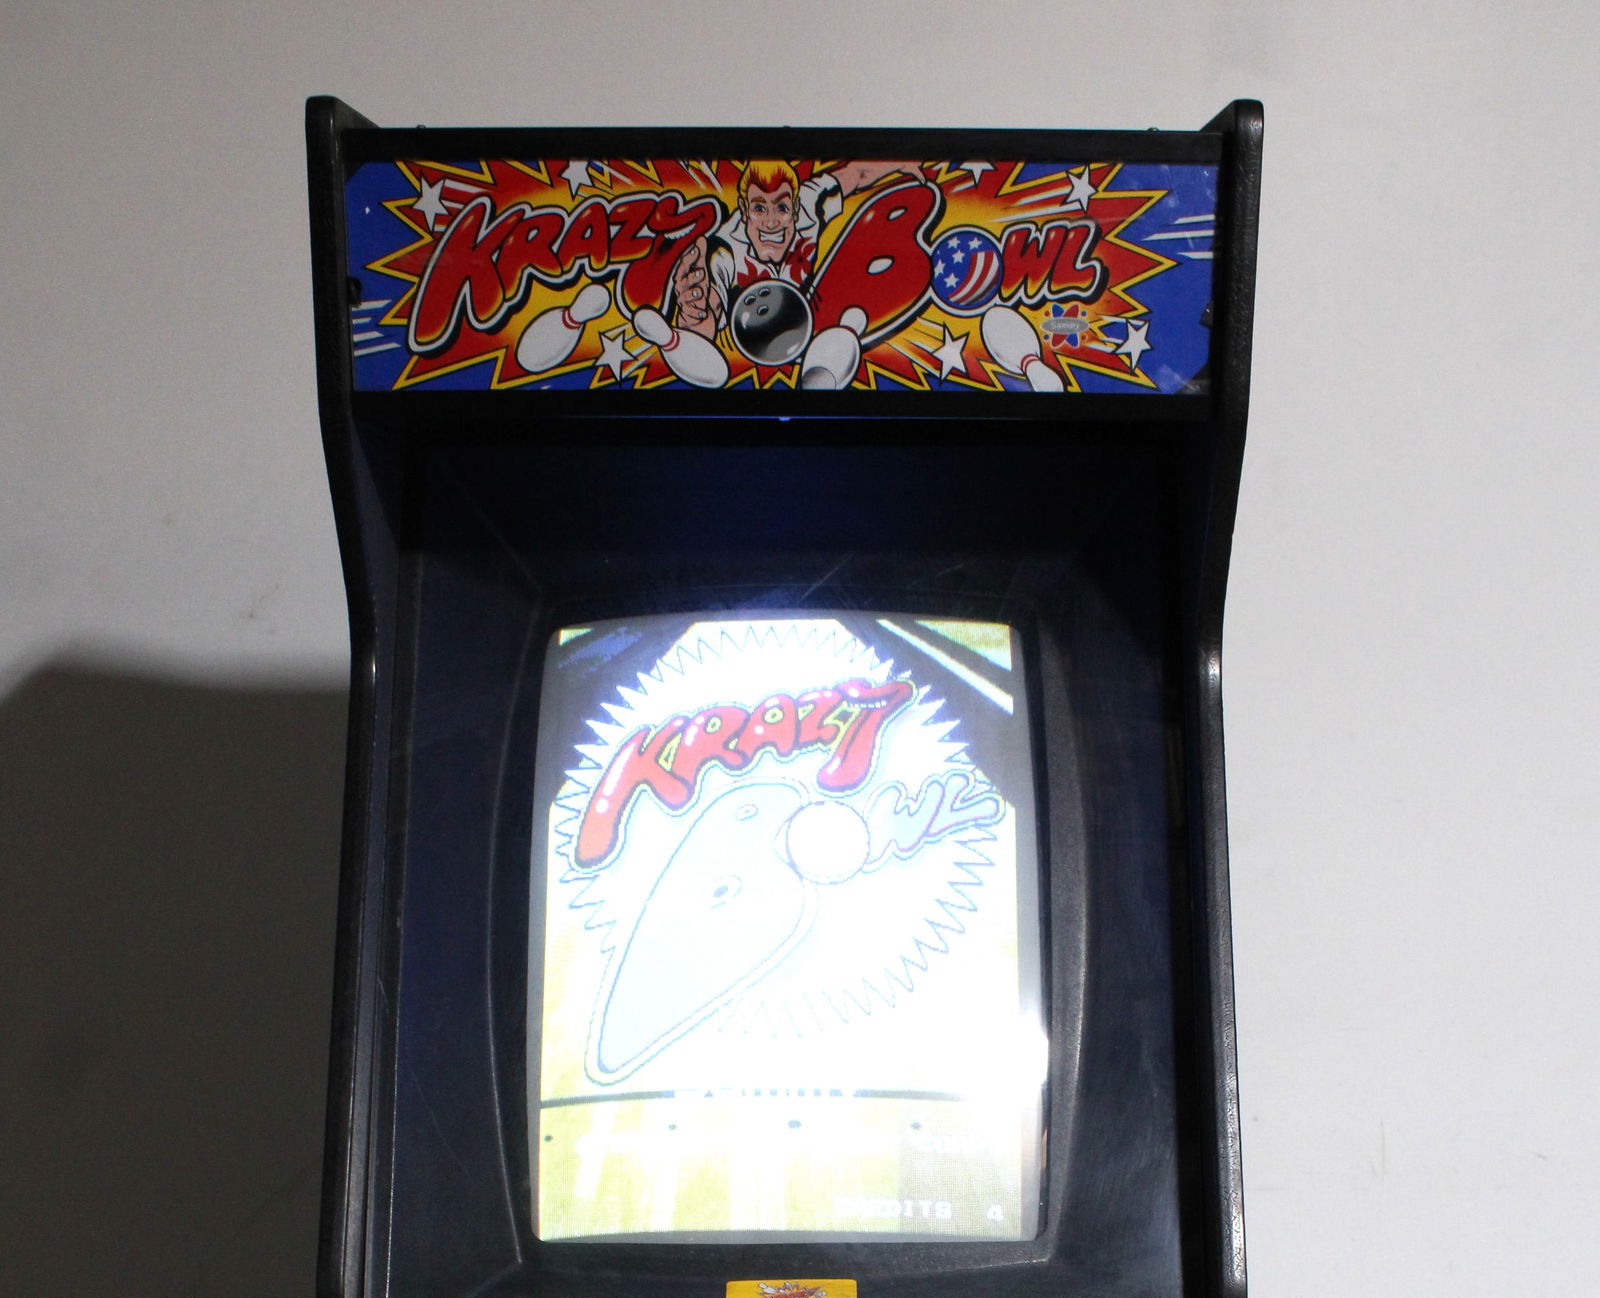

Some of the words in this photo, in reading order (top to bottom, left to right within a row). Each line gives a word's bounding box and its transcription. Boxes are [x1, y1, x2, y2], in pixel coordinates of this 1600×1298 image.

[406, 190, 724, 356] KRAZY
[808, 176, 1108, 346] BOWL
[573, 677, 918, 872] KRAZY
